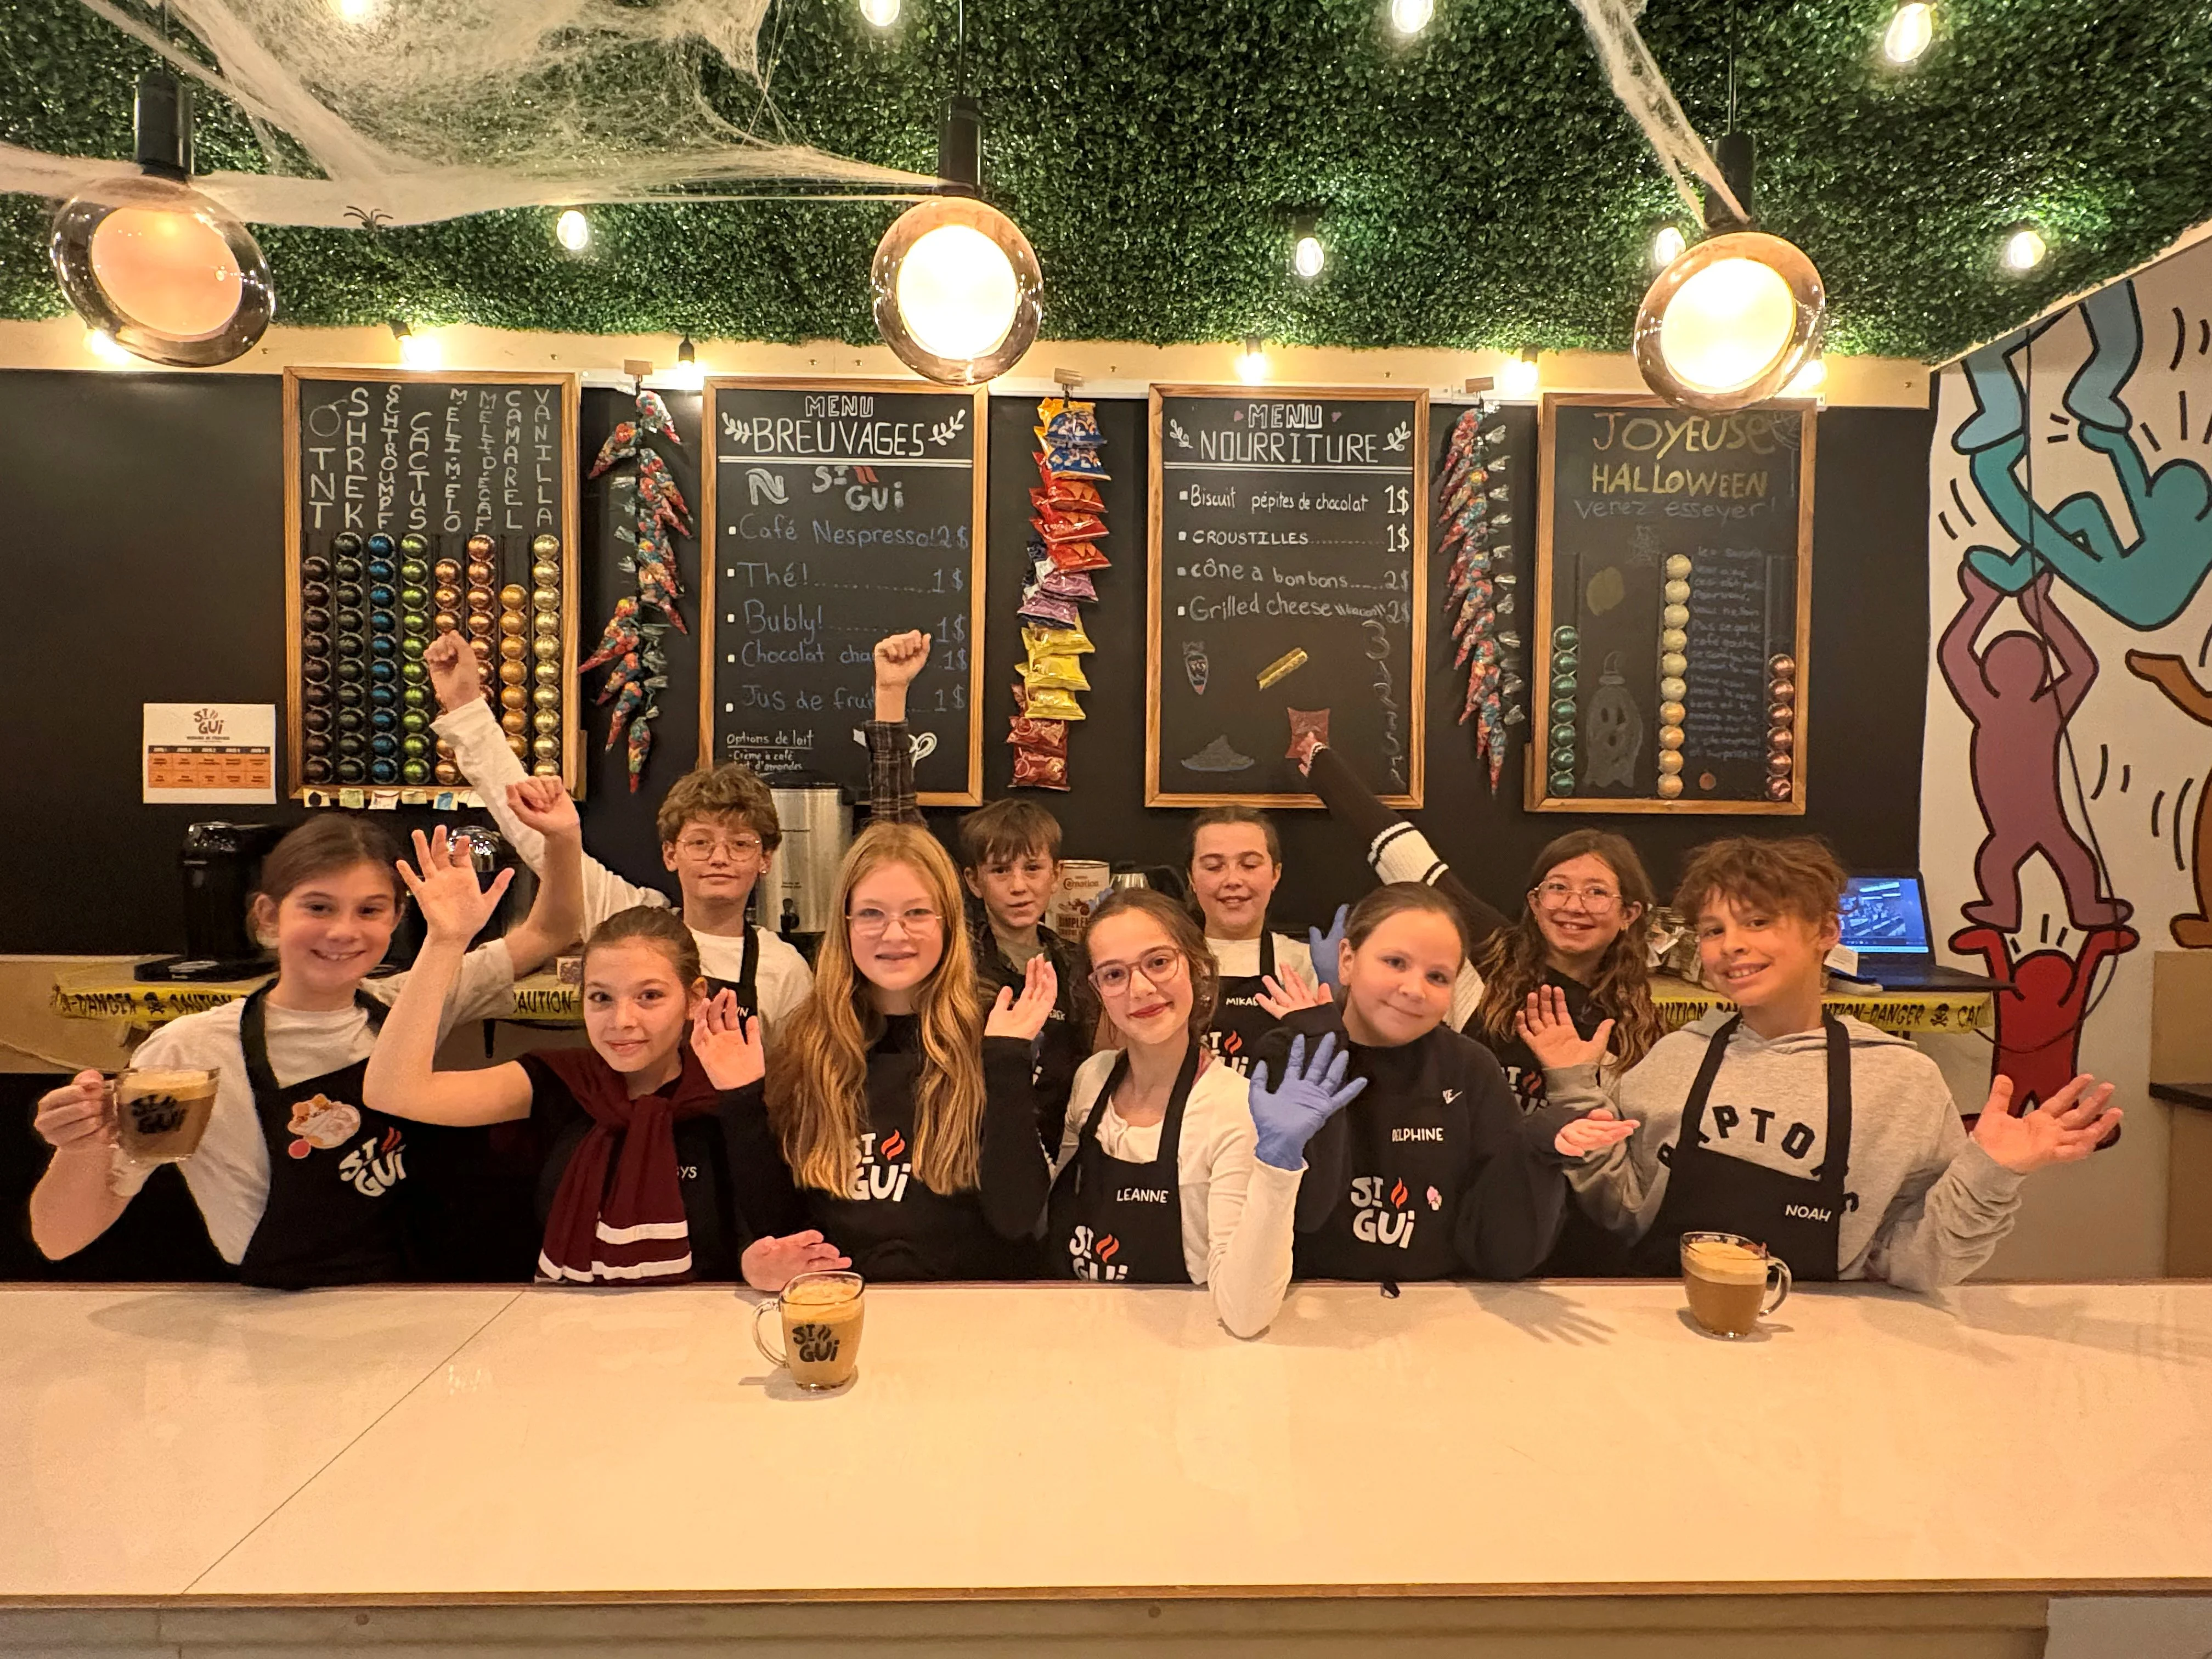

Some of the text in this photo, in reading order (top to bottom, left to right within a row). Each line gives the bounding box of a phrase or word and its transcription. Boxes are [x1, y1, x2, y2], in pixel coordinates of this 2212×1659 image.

[805, 396, 873, 417] MENU
[1249, 403, 1322, 429] MENU
[752, 417, 925, 456] BREUVAGES
[1200, 431, 1378, 464] NOURRITURE
[345, 387, 369, 529] SHREK
[377, 384, 402, 530] SCHTROUMPF
[408, 411, 432, 530] CACTUS
[503, 391, 523, 530] CAMAREL
[534, 388, 553, 528] VANILLA
[308, 448, 336, 529] TNT
[1592, 461, 1769, 499] HALLOWEEN
[1191, 484, 1236, 509] Biscuit
[1251, 492, 1294, 515] pépites
[1299, 493, 1311, 511] de
[1316, 493, 1369, 513] chocolat
[740, 513, 797, 540] Café
[1193, 529, 1308, 546] CROUSTILLES
[737, 562, 808, 588] Thé!
[1273, 567, 1347, 589] bonbons
[1189, 594, 1260, 621] Grilled
[1266, 597, 1333, 617] cheese
[744, 599, 823, 645] Bubly!
[741, 641, 825, 667] Chocolat
[797, 688, 823, 711] de
[727, 730, 814, 747] Options de lait
[774, 749, 794, 761] café
[1116, 1188, 1169, 1204] LEANNE
[1785, 1205, 1832, 1222] NOAH
